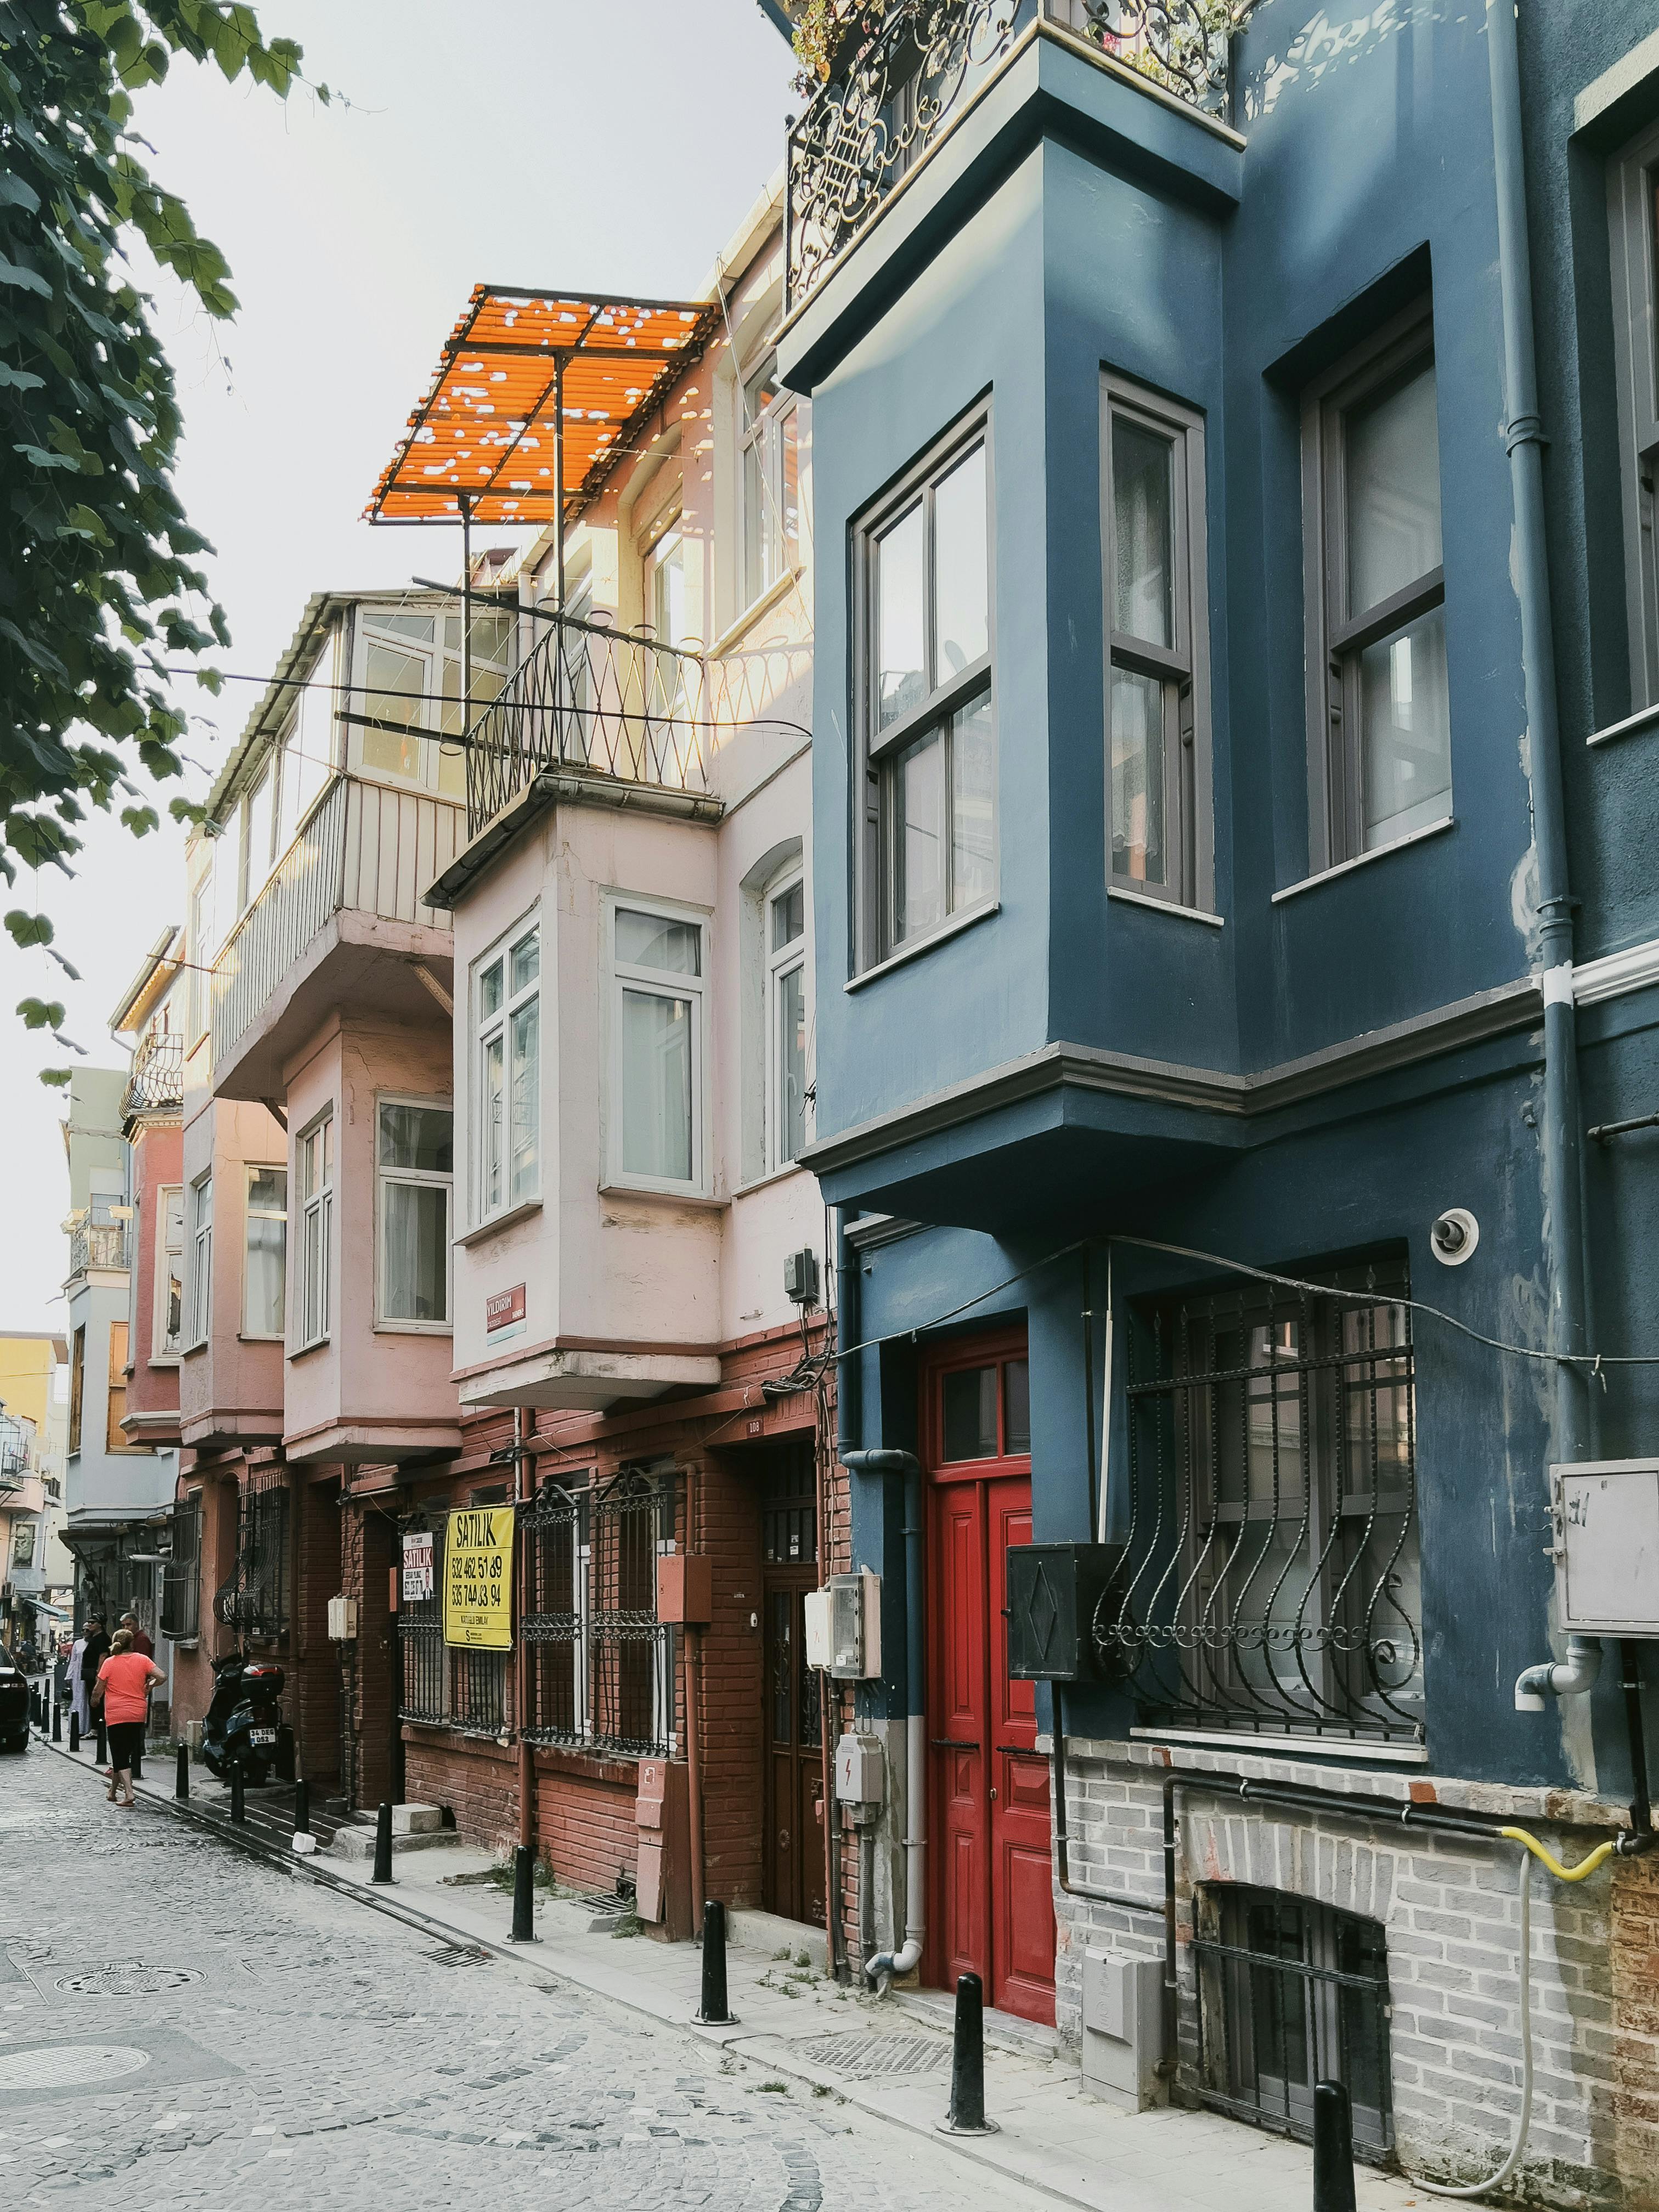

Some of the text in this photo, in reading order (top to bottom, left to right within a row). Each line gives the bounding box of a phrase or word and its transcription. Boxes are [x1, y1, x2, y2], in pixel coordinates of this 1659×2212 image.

[487, 1295, 512, 1317] YILDIRIM
[457, 1513, 496, 1548] SATILIK
[404, 1548, 431, 1568] SATILIK
[478, 1556, 488, 1579] 51
[490, 1584, 501, 1607] 94
